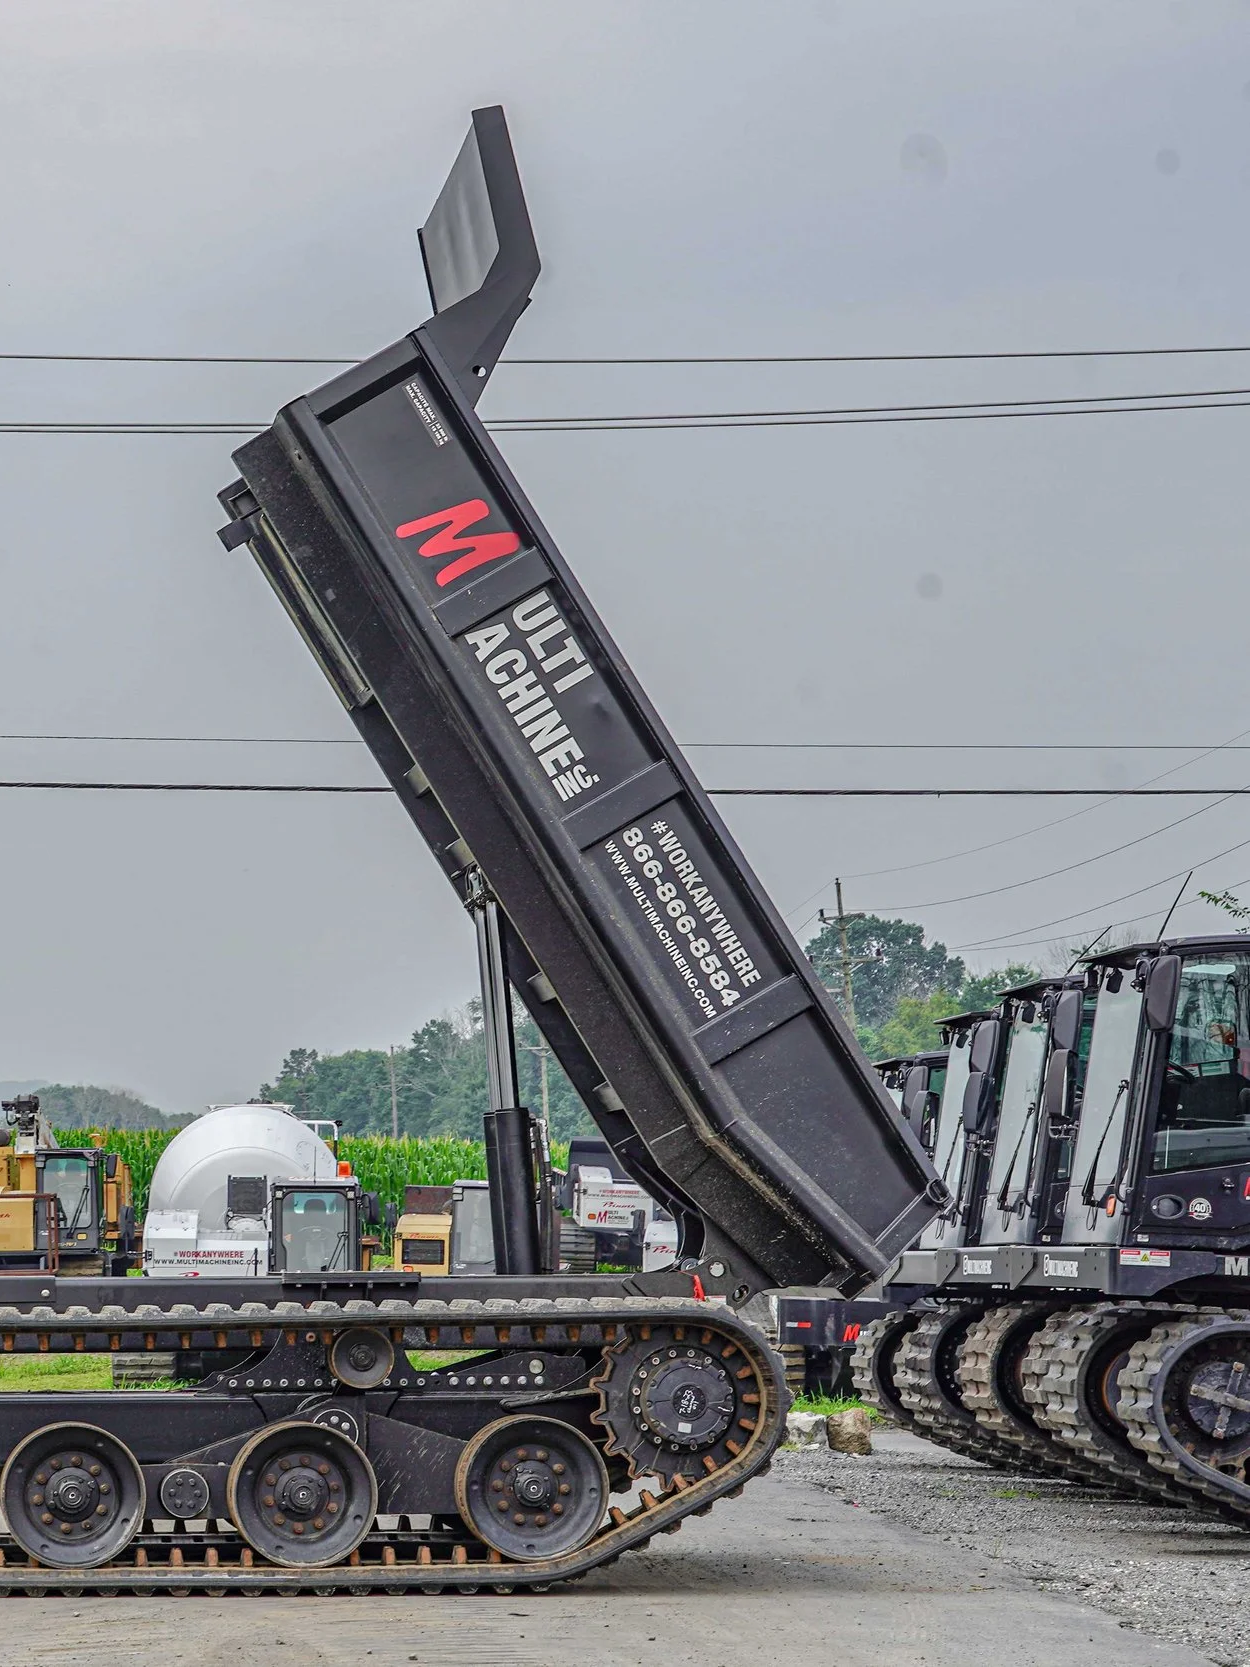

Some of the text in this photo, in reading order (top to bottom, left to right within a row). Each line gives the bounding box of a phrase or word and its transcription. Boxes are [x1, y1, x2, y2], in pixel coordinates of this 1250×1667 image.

[413, 398, 431, 423] CAPACITY
[464, 622, 585, 778] ACHINE
[551, 764, 600, 802] INC.
[604, 839, 718, 1019] WWW.MULTIMACHINEINC.COM
[622, 826, 741, 1007] 866-866-8584
[650, 820, 762, 988] #WORKANYWHERE
[1194, 1203, 1206, 1213] 40
